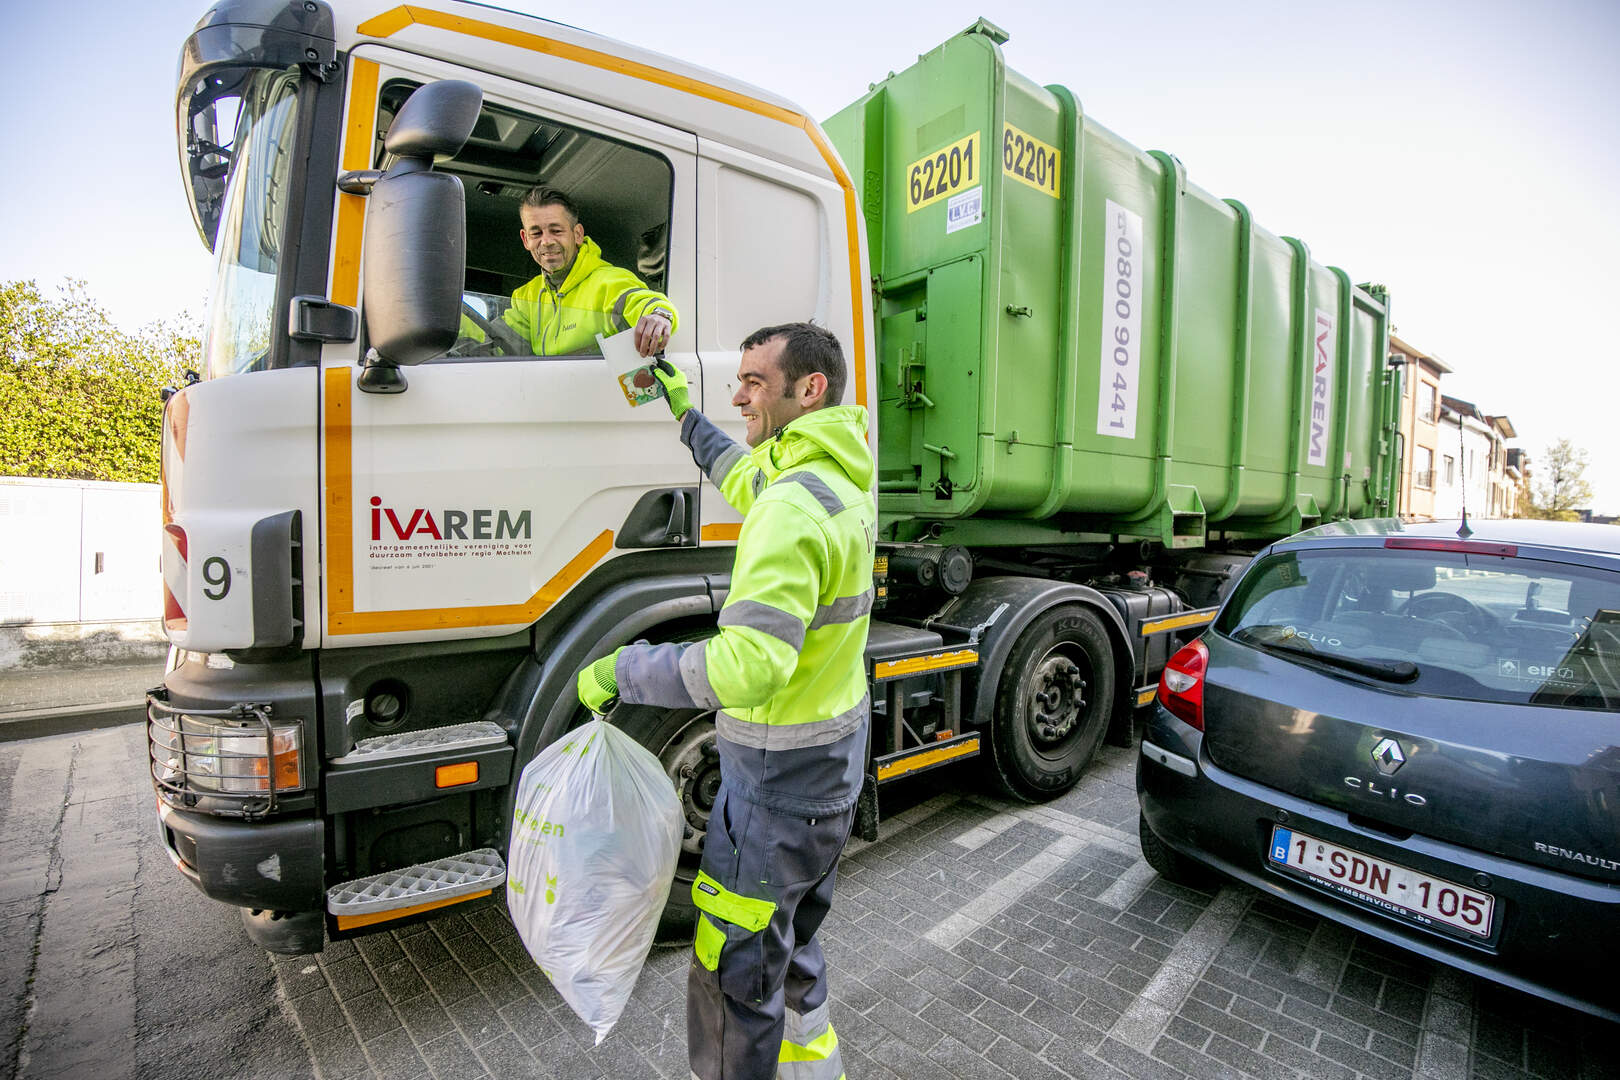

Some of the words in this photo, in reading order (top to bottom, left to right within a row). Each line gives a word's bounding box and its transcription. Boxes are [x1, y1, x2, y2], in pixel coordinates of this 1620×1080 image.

[910, 138, 974, 205] 62201
[1003, 128, 1056, 191] 62201
[1115, 238, 1132, 320] 0800
[1114, 326, 1130, 366] 90
[1109, 372, 1128, 429] 441
[202, 556, 231, 601] 9
[1296, 630, 1343, 647] CLIO
[1344, 776, 1426, 806] CLIO
[1275, 846, 1286, 860] B
[1534, 842, 1620, 871] RENAULT
